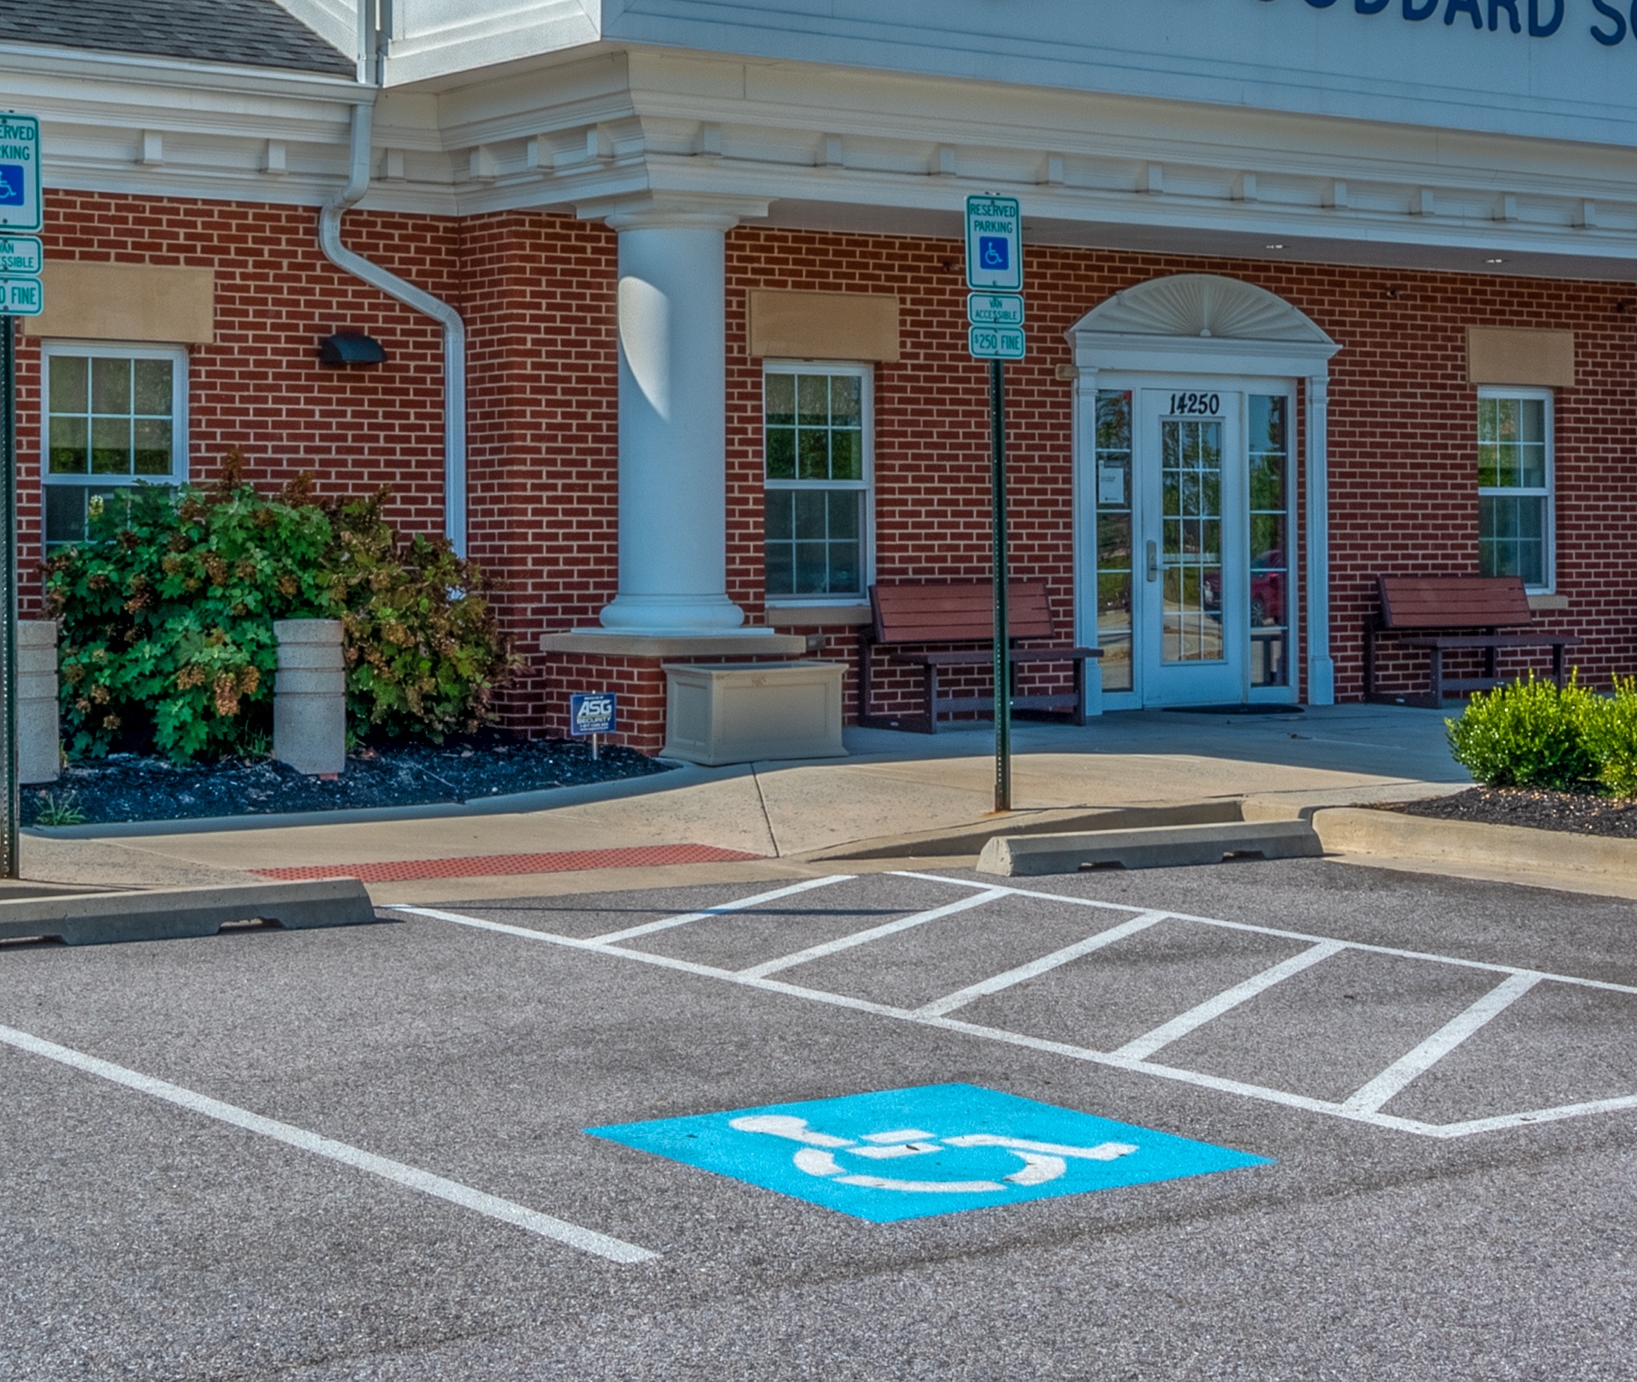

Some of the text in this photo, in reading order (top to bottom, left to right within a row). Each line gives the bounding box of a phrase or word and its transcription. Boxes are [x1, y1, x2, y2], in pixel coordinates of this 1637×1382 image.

[970, 203, 1016, 218] RESERVED
[974, 220, 1013, 234] PARKING
[11, 286, 36, 305] FINE
[989, 299, 1003, 309] VAN
[975, 310, 1018, 320] ACCESSIBLE
[974, 333, 1020, 350] $250 FINE
[1169, 392, 1220, 415] 14250
[577, 699, 612, 716] ASG
[576, 716, 611, 724] SECURITY
